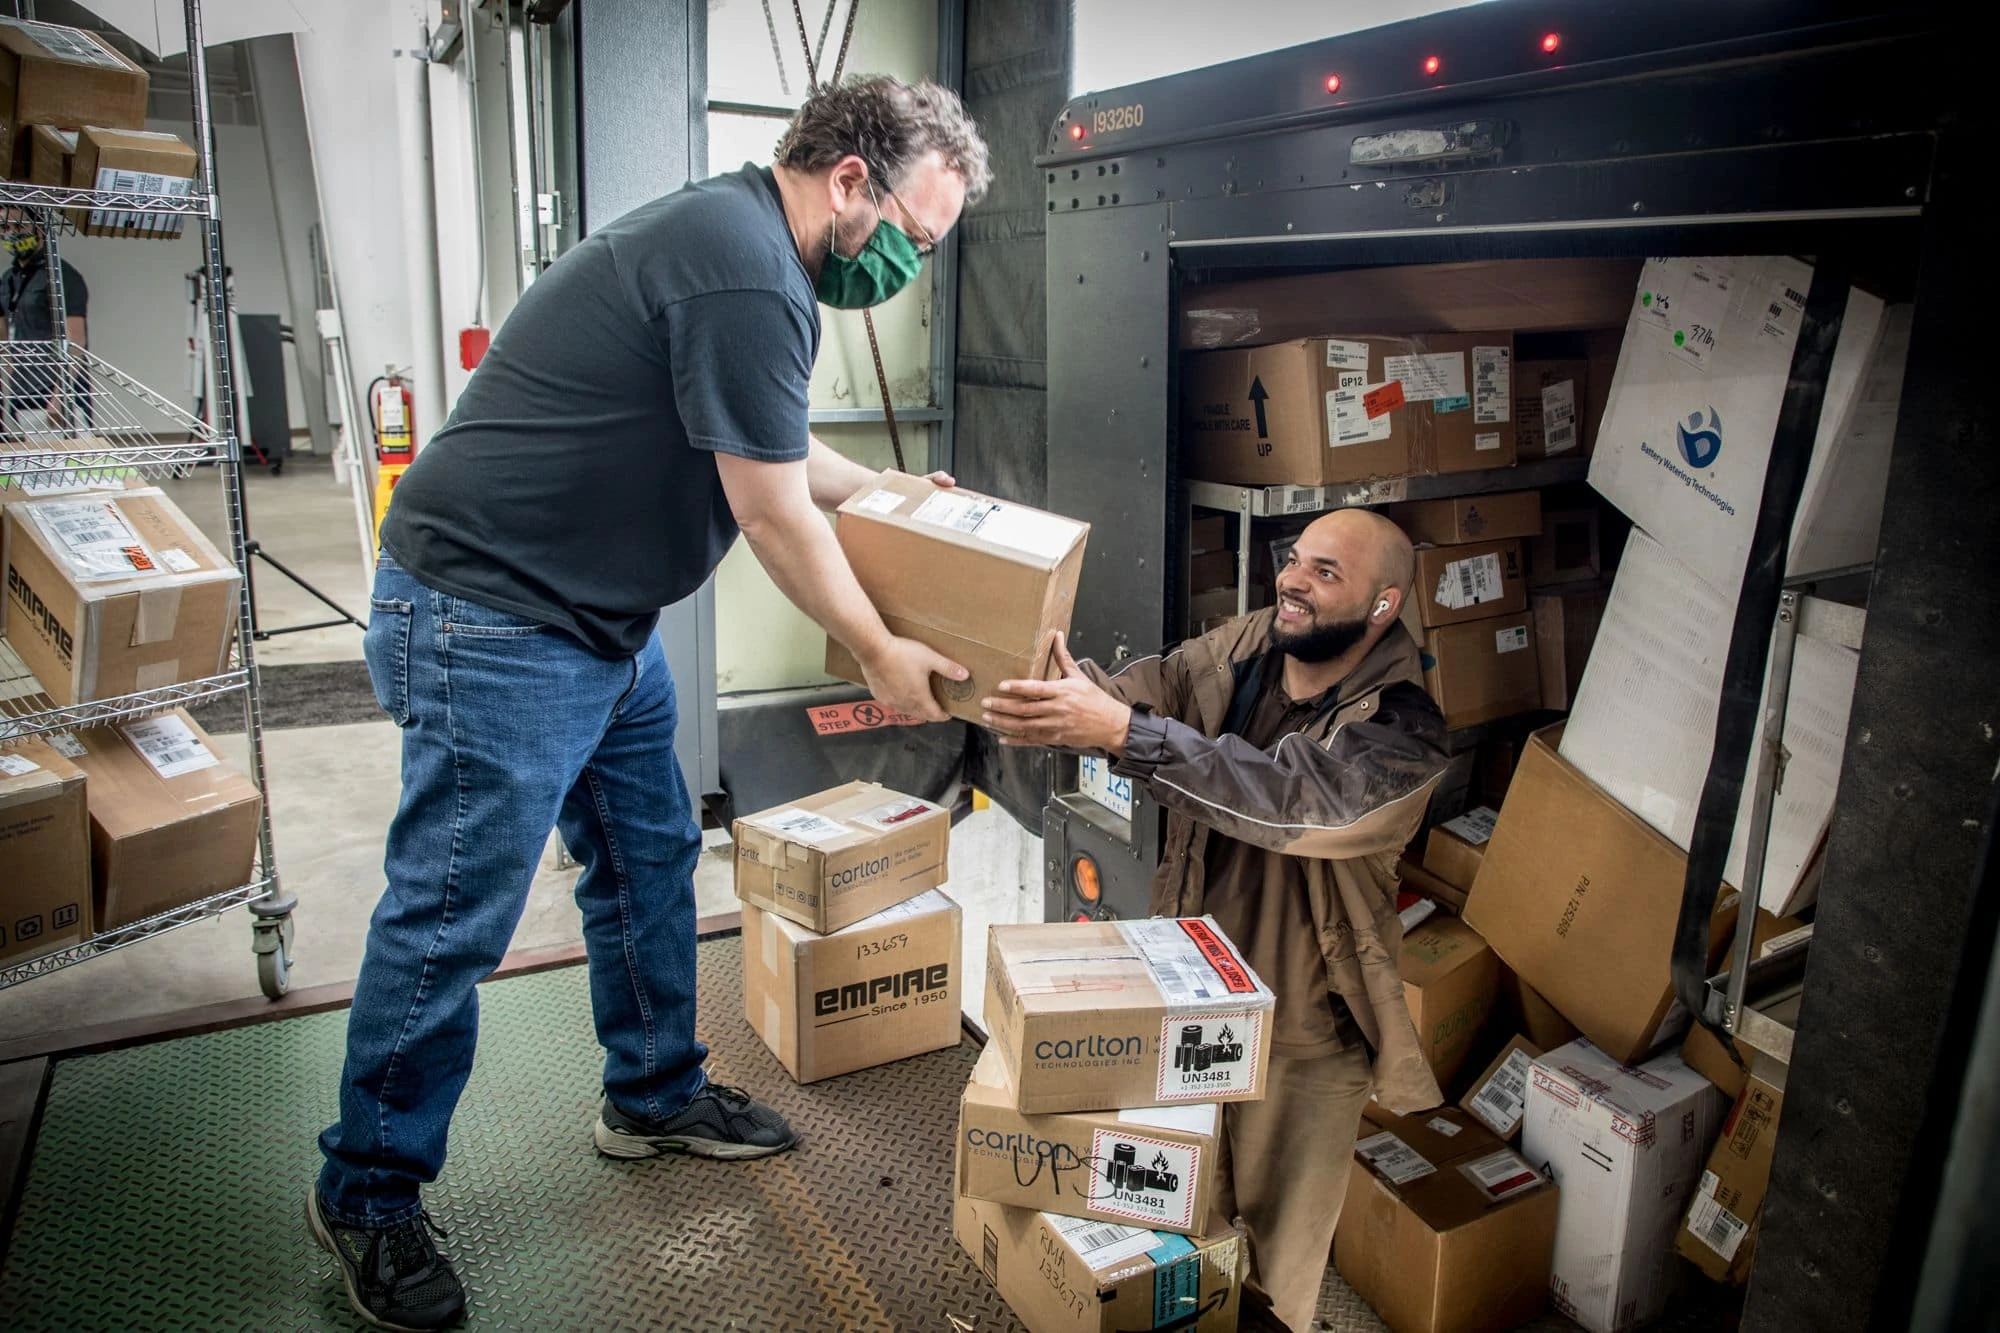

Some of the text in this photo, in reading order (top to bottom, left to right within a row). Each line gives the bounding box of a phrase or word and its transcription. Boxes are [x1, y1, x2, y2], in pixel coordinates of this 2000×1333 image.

[1093, 103, 1144, 135] 193260
[1341, 377, 1363, 387] GP12
[1231, 419, 1251, 431] CARE
[1257, 443, 1272, 457] UP
[1640, 441, 1735, 516] Battery Watering Technologies
[818, 714, 912, 731] STEP STE
[819, 710, 839, 720] NO
[831, 856, 889, 888] carlton
[857, 933, 909, 961] 133659
[815, 963, 948, 1017] EMPIRE
[871, 990, 947, 1017] Since 1950
[1035, 1035, 1142, 1060] carlton
[1034, 1060, 1117, 1070] TECHNOLOGIES
[1182, 1070, 1231, 1084] UN3481
[967, 1128, 1071, 1162] carlton
[1114, 1190, 1166, 1209] UN3481
[1039, 1226, 1066, 1278] RMA
